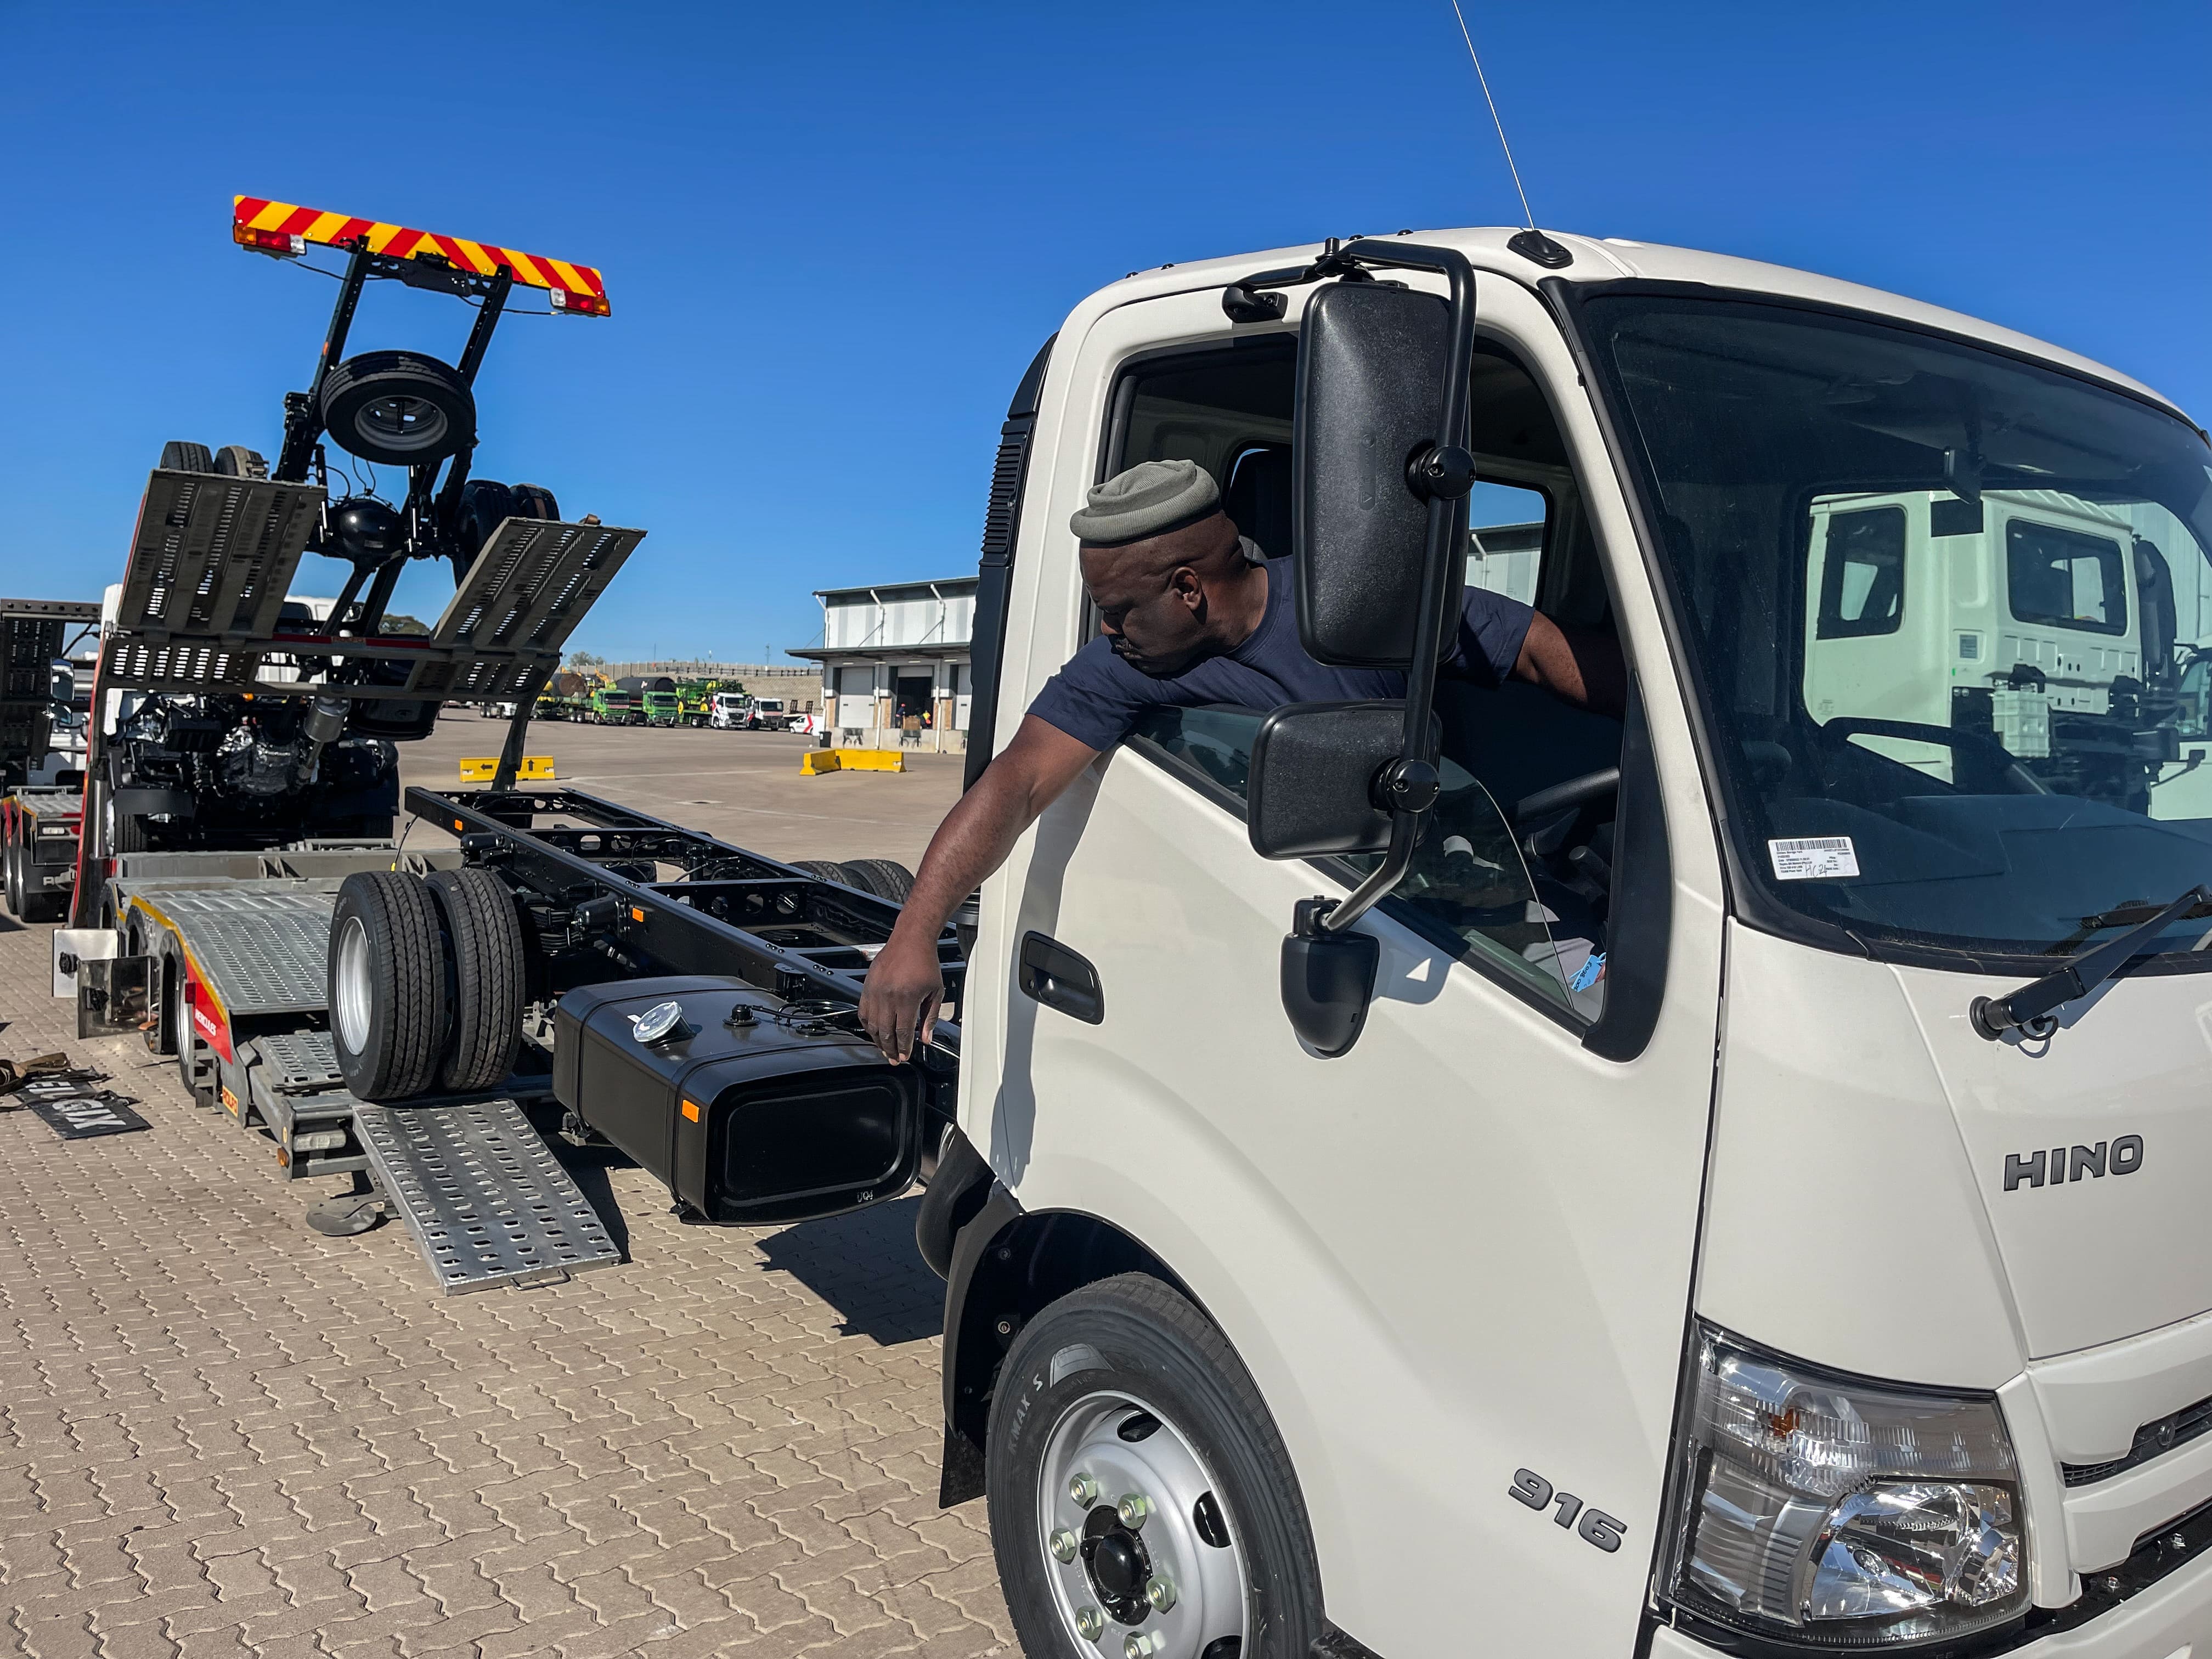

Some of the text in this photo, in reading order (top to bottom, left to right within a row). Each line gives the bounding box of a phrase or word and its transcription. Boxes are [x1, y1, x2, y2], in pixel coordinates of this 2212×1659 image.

[1580, 961, 1592, 978] 8603
[2004, 1134, 2144, 1192] HINO
[1032, 1373, 1043, 1391] S
[1508, 1468, 1628, 1553] 916
